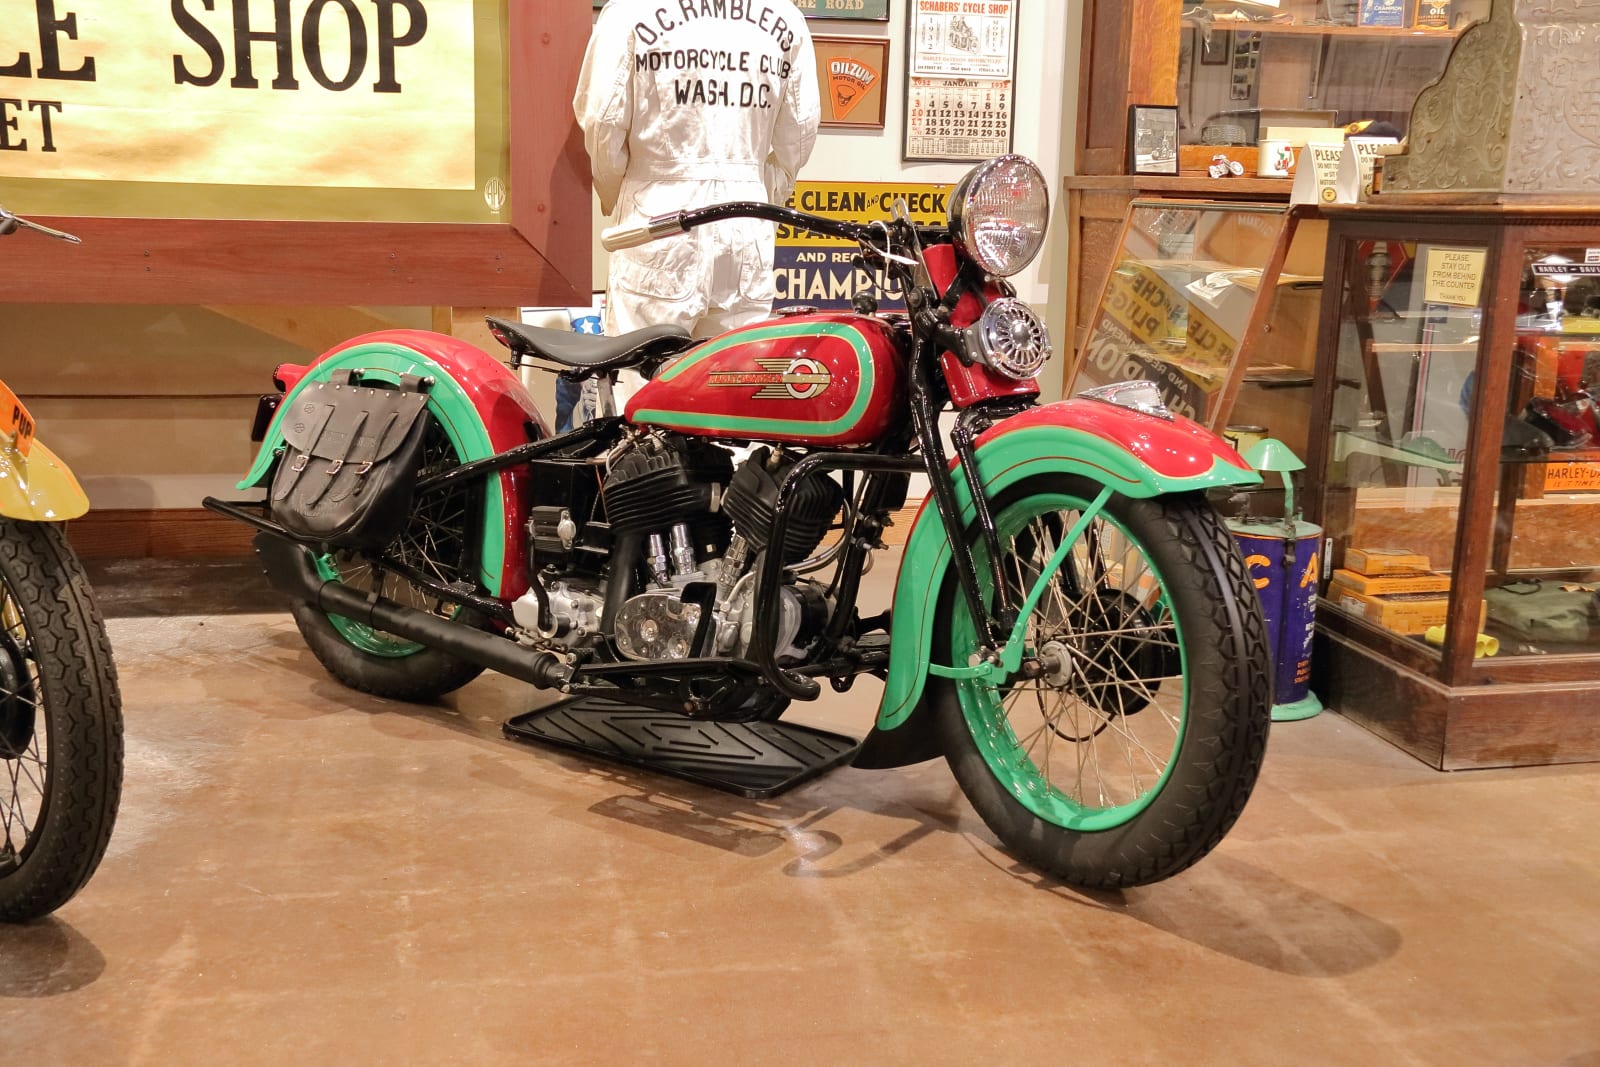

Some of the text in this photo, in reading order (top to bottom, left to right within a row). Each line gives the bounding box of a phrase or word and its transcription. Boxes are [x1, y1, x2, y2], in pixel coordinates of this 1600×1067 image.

[794, 0, 864, 9] HE ROAD
[963, 3, 985, 13] CYCLE
[988, 4, 1008, 14] SHOP
[678, 0, 794, 51] RAMBLERS
[171, 0, 428, 93] SHOP
[636, 49, 749, 72] MOTORCYCLE
[831, 61, 875, 85] OILZUM
[833, 75, 866, 90] MOTOR OIL
[943, 80, 979, 88] JANUARY
[675, 79, 771, 108] WASH. D.C.
[911, 109, 924, 117] 10
[954, 110, 965, 118] 13
[982, 111, 994, 119] 15
[0, 98, 62, 152] ET
[911, 118, 923, 126] 17
[926, 118, 937, 126] 18
[940, 119, 951, 127] 19
[981, 120, 993, 128] 22
[939, 128, 950, 136] 26
[981, 129, 992, 137] 29
[1315, 149, 1342, 161] PLEAS
[801, 191, 866, 212] CLEAN
[866, 194, 880, 208] AND
[796, 252, 827, 263] AND
[1444, 253, 1470, 261] PLEASE
[1441, 262, 1457, 270] STAY
[1432, 270, 1476, 280] FROM BEHIND
[773, 267, 903, 301] CHAMPIO
[1446, 281, 1475, 289] COUNTER
[12, 404, 33, 439] PUP
